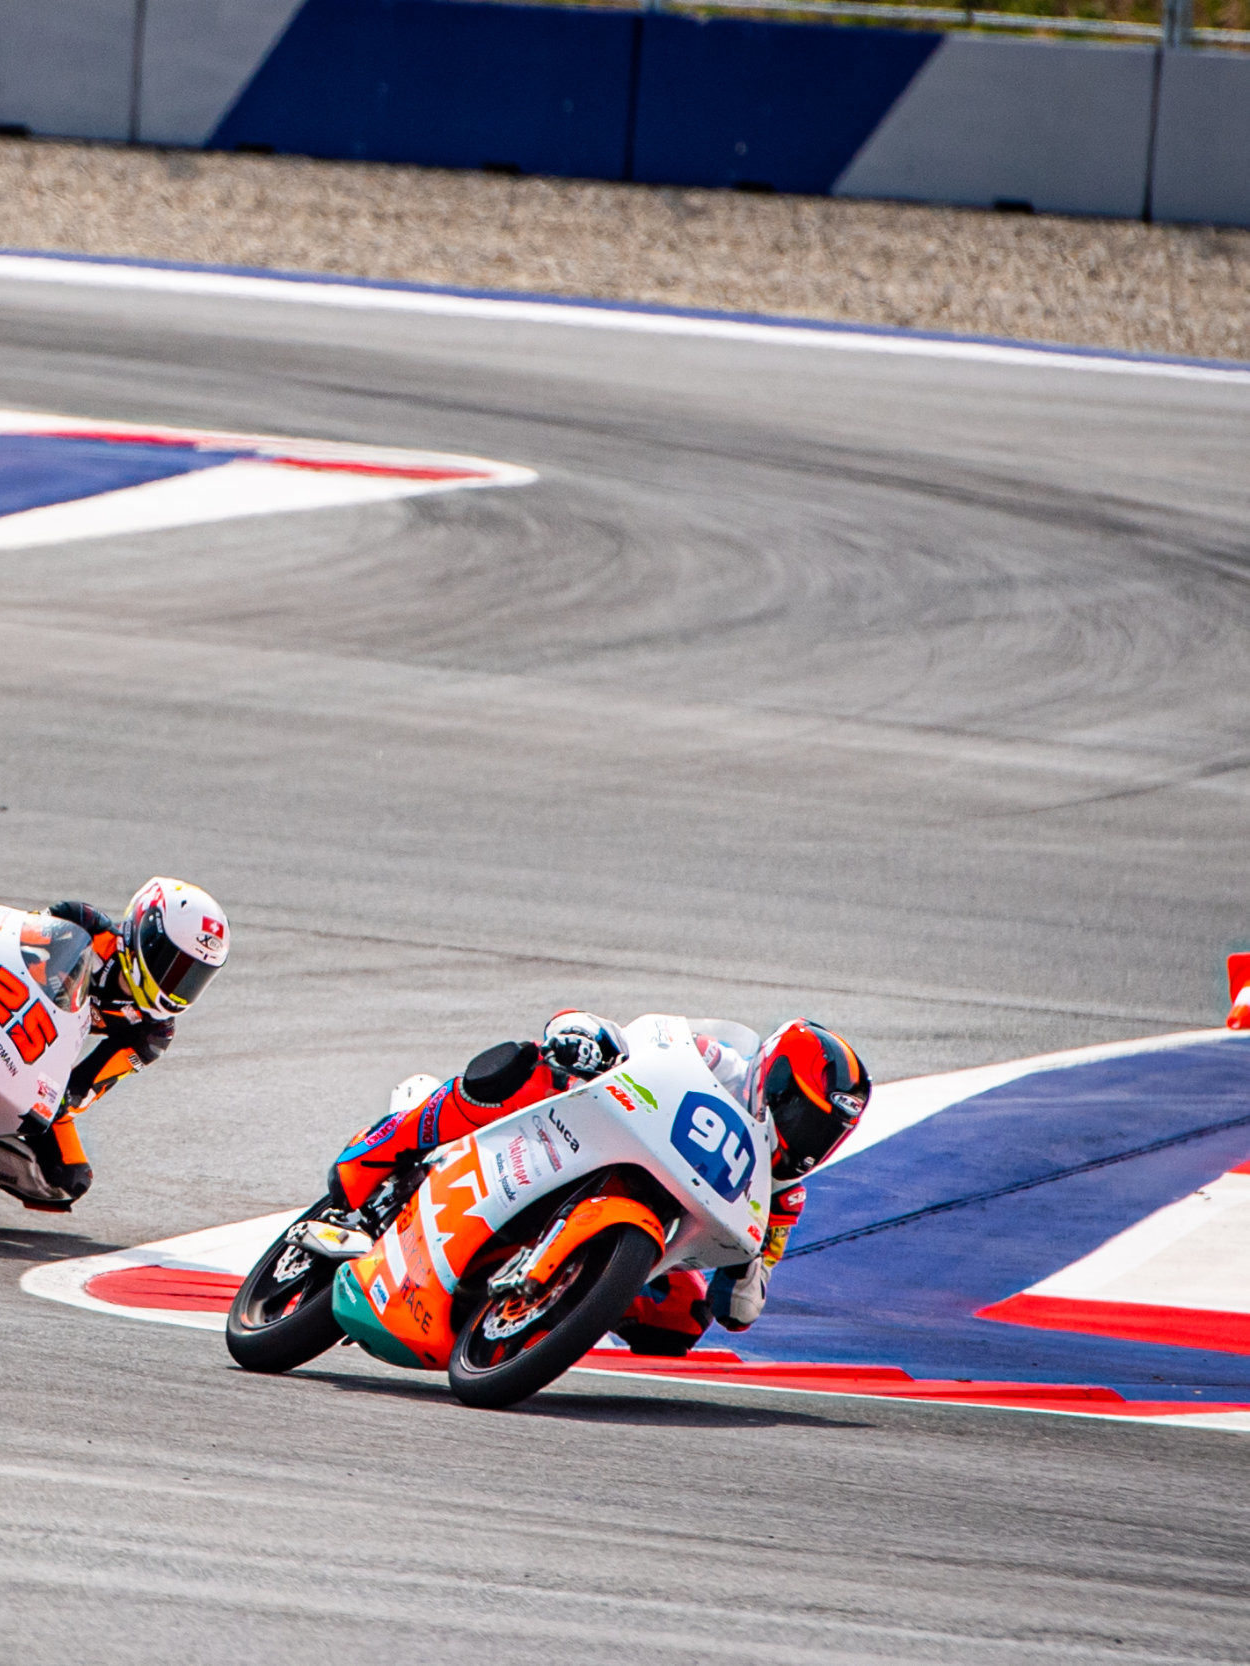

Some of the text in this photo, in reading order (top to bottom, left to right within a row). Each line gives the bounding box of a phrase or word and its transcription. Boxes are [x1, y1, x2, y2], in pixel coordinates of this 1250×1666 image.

[605, 1085, 637, 1112] KTM
[548, 1107, 581, 1154] Luca
[687, 1105, 751, 1189] 94
